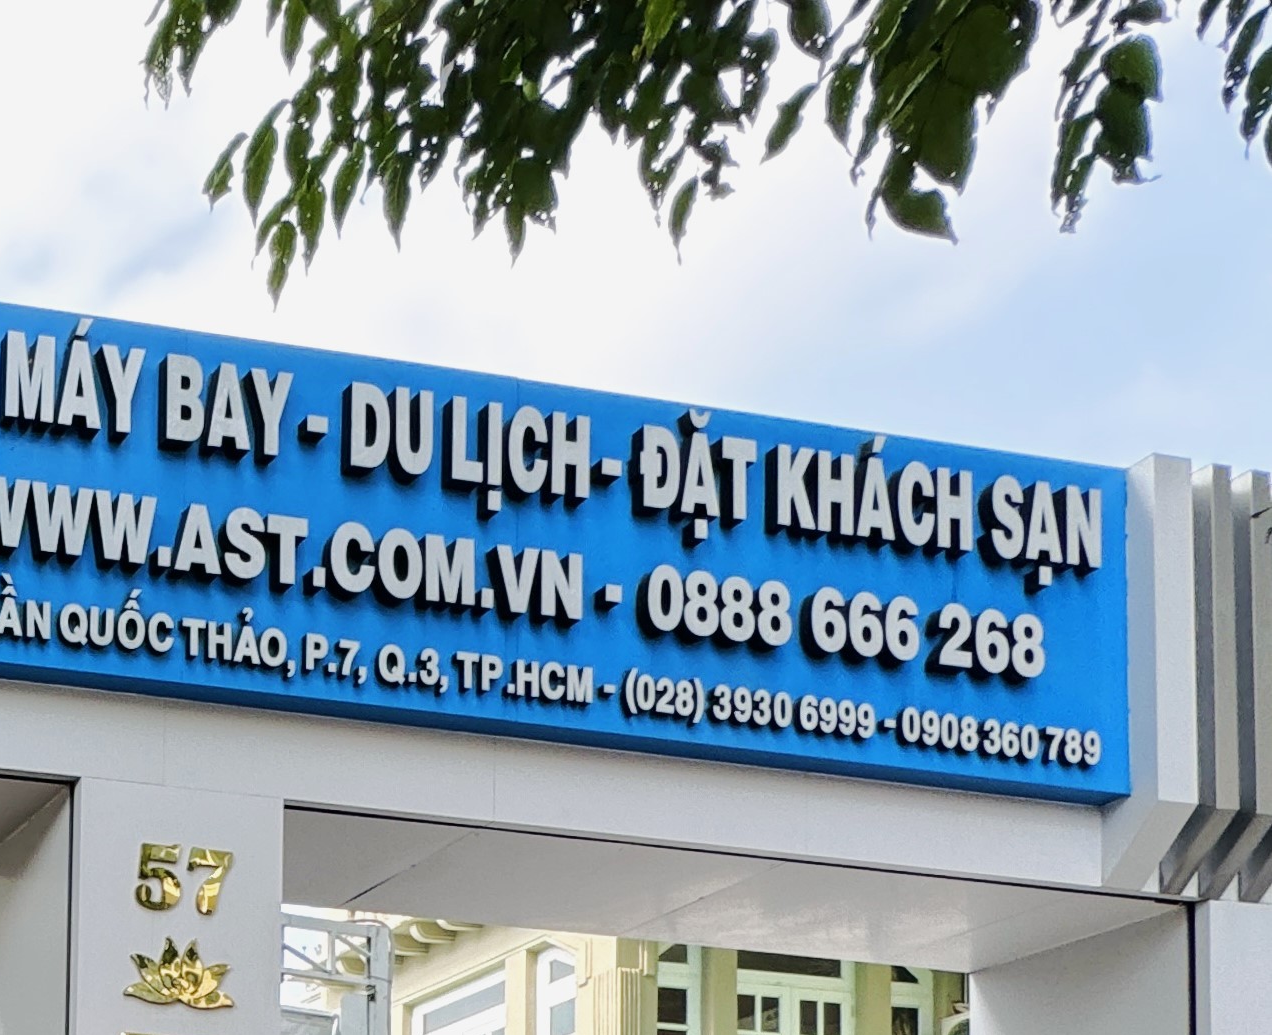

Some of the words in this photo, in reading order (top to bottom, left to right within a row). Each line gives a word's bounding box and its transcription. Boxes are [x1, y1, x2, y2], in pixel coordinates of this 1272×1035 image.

[3, 317, 147, 437] MÁY
[165, 353, 294, 458] BAY
[350, 380, 434, 477] DU
[450, 394, 591, 513] LỊCH
[639, 408, 757, 540] ĐẶT
[776, 434, 974, 552] KHÁCH
[990, 474, 1102, 587] SẠN
[59, 588, 174, 653] QUỐC
[181, 607, 296, 679] THẢO,
[304, 631, 368, 686] P.7,
[377, 644, 450, 694] Q.3,
[625, 666, 706, 724] (028)
[712, 683, 794, 729] 3930
[799, 696, 876, 740] 6999
[646, 562, 793, 648] 0888
[810, 586, 920, 662] 666
[937, 602, 1046, 679] 268
[135, 842, 234, 916] 57
